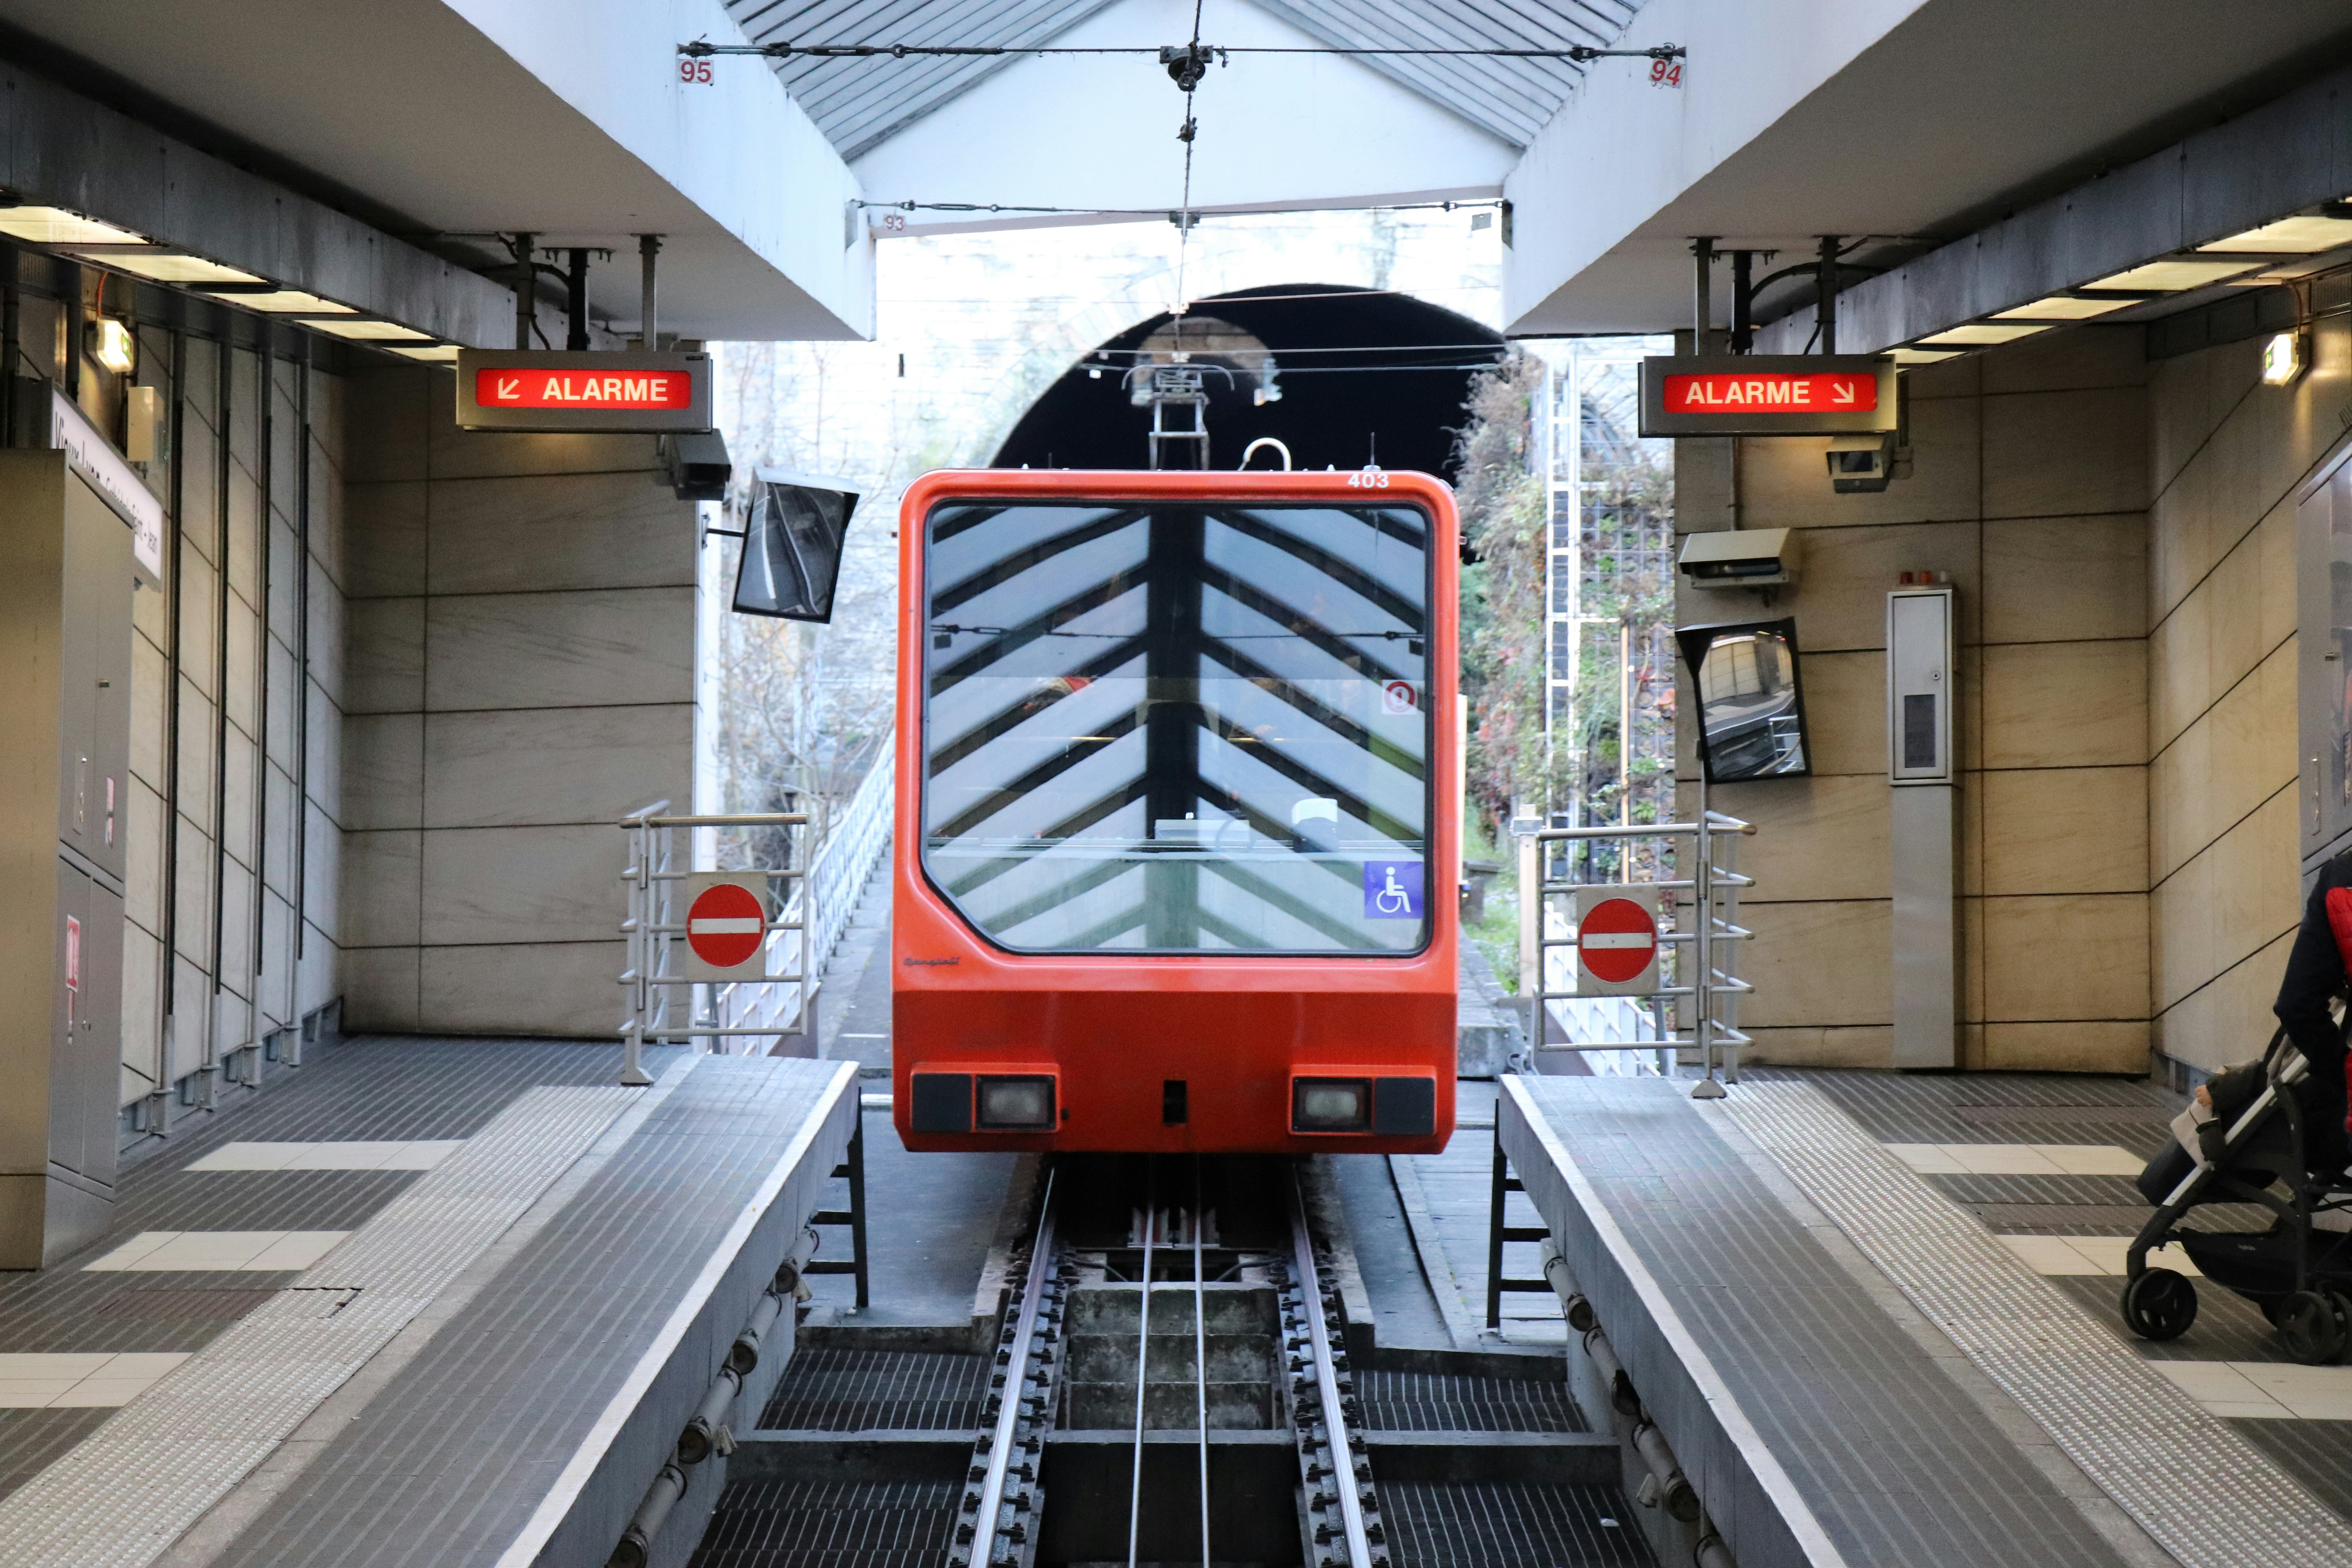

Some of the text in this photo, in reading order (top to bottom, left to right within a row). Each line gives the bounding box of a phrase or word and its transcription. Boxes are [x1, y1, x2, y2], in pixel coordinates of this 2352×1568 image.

[681, 61, 711, 82] 95
[1651, 60, 1681, 86] 94
[886, 216, 904, 230] 93
[542, 377, 668, 401] ALARME
[1685, 381, 1810, 404] ALARME
[1347, 473, 1389, 488] 403
